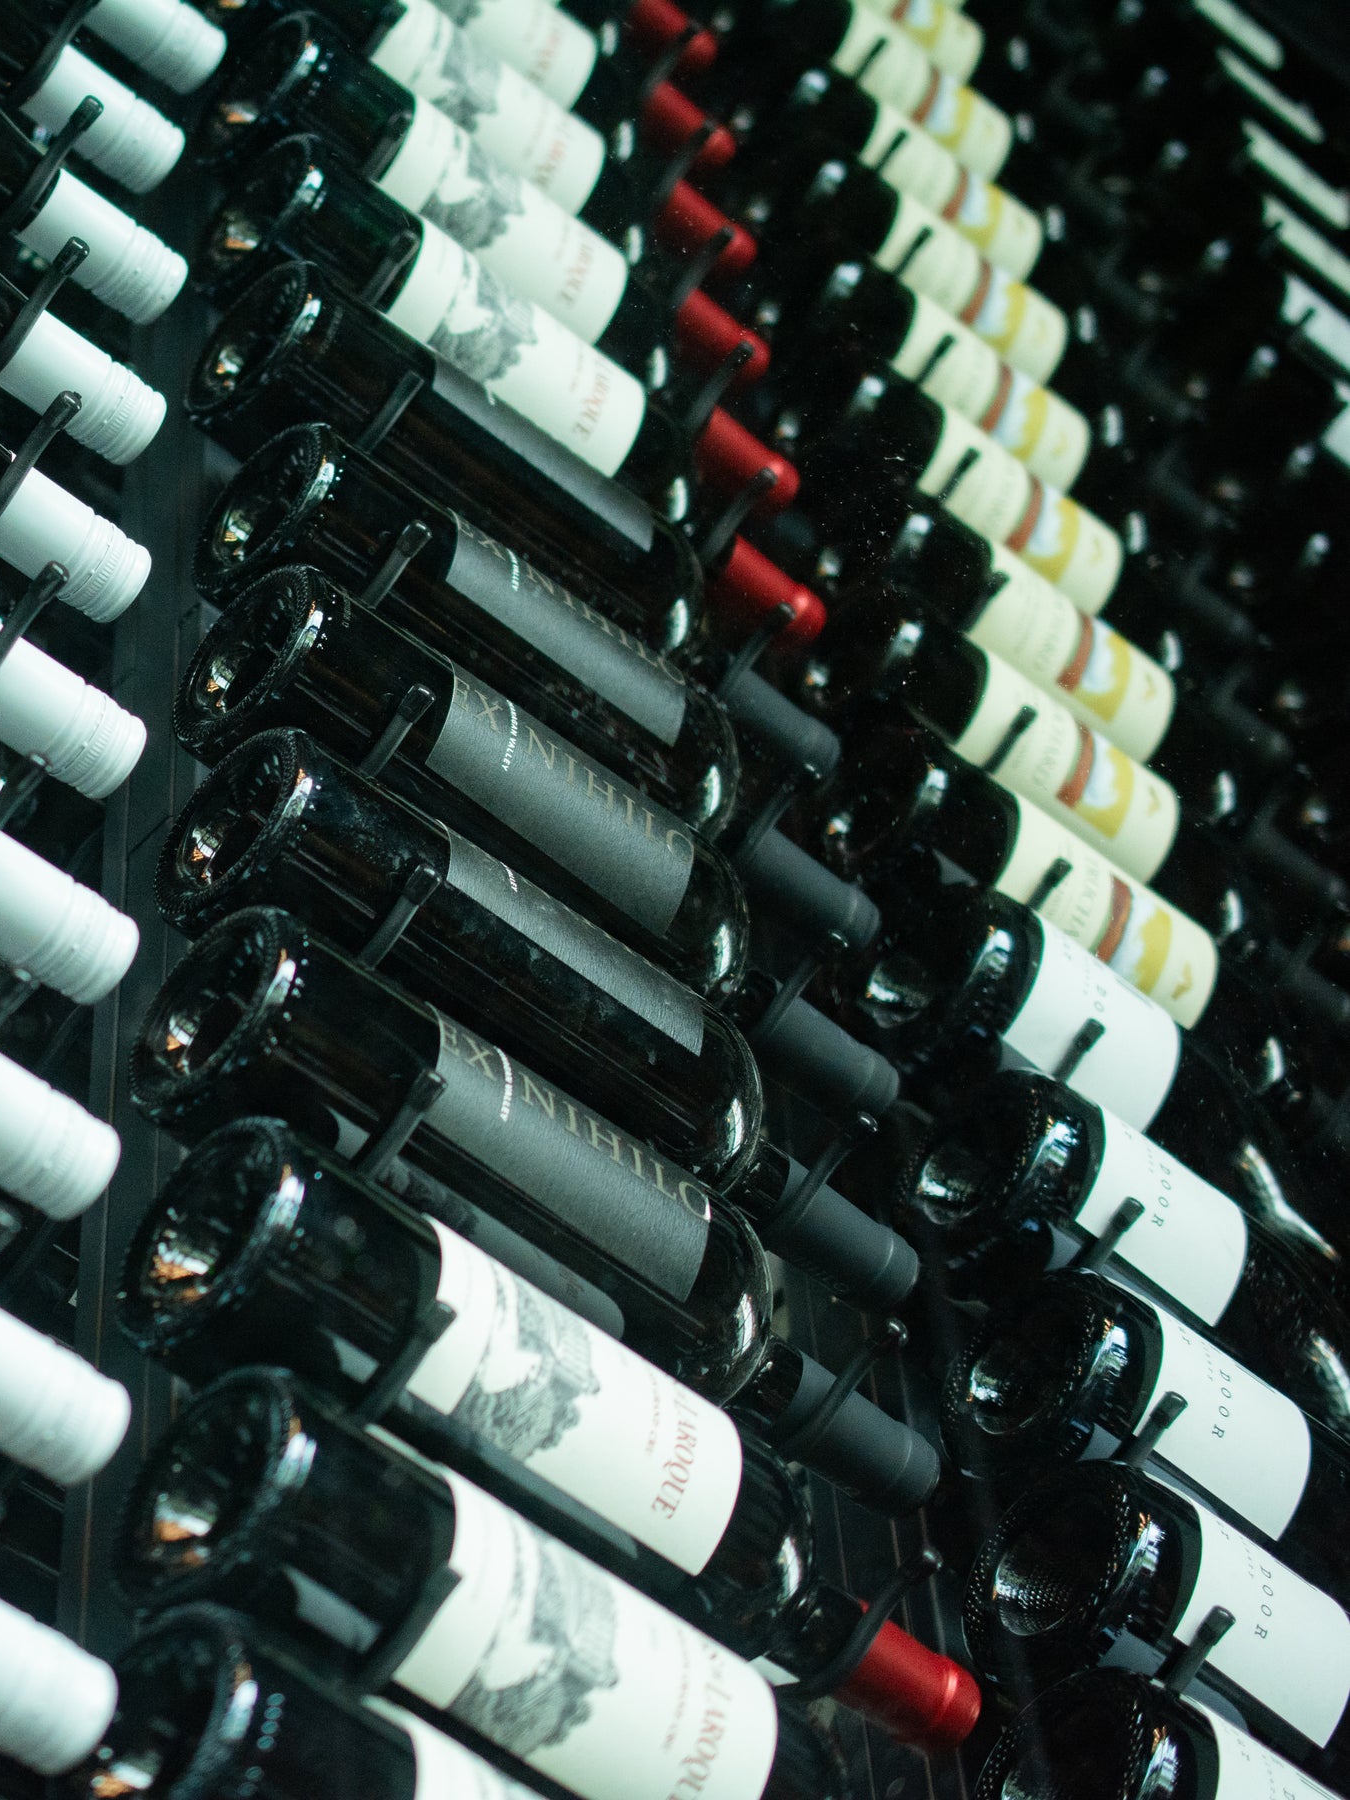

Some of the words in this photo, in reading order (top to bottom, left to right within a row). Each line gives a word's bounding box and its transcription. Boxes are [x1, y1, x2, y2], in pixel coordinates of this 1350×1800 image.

[453, 676, 504, 734] EX
[523, 724, 695, 864] NIHILO
[501, 737, 518, 772] VALLEY
[443, 1022, 497, 1082] EX
[518, 1070, 712, 1223] NIHILO
[1152, 1162, 1172, 1227] DOOR
[1211, 1368, 1232, 1439] DOOR
[651, 1399, 698, 1520] LAROQUE
[1254, 1564, 1274, 1639] DOOR
